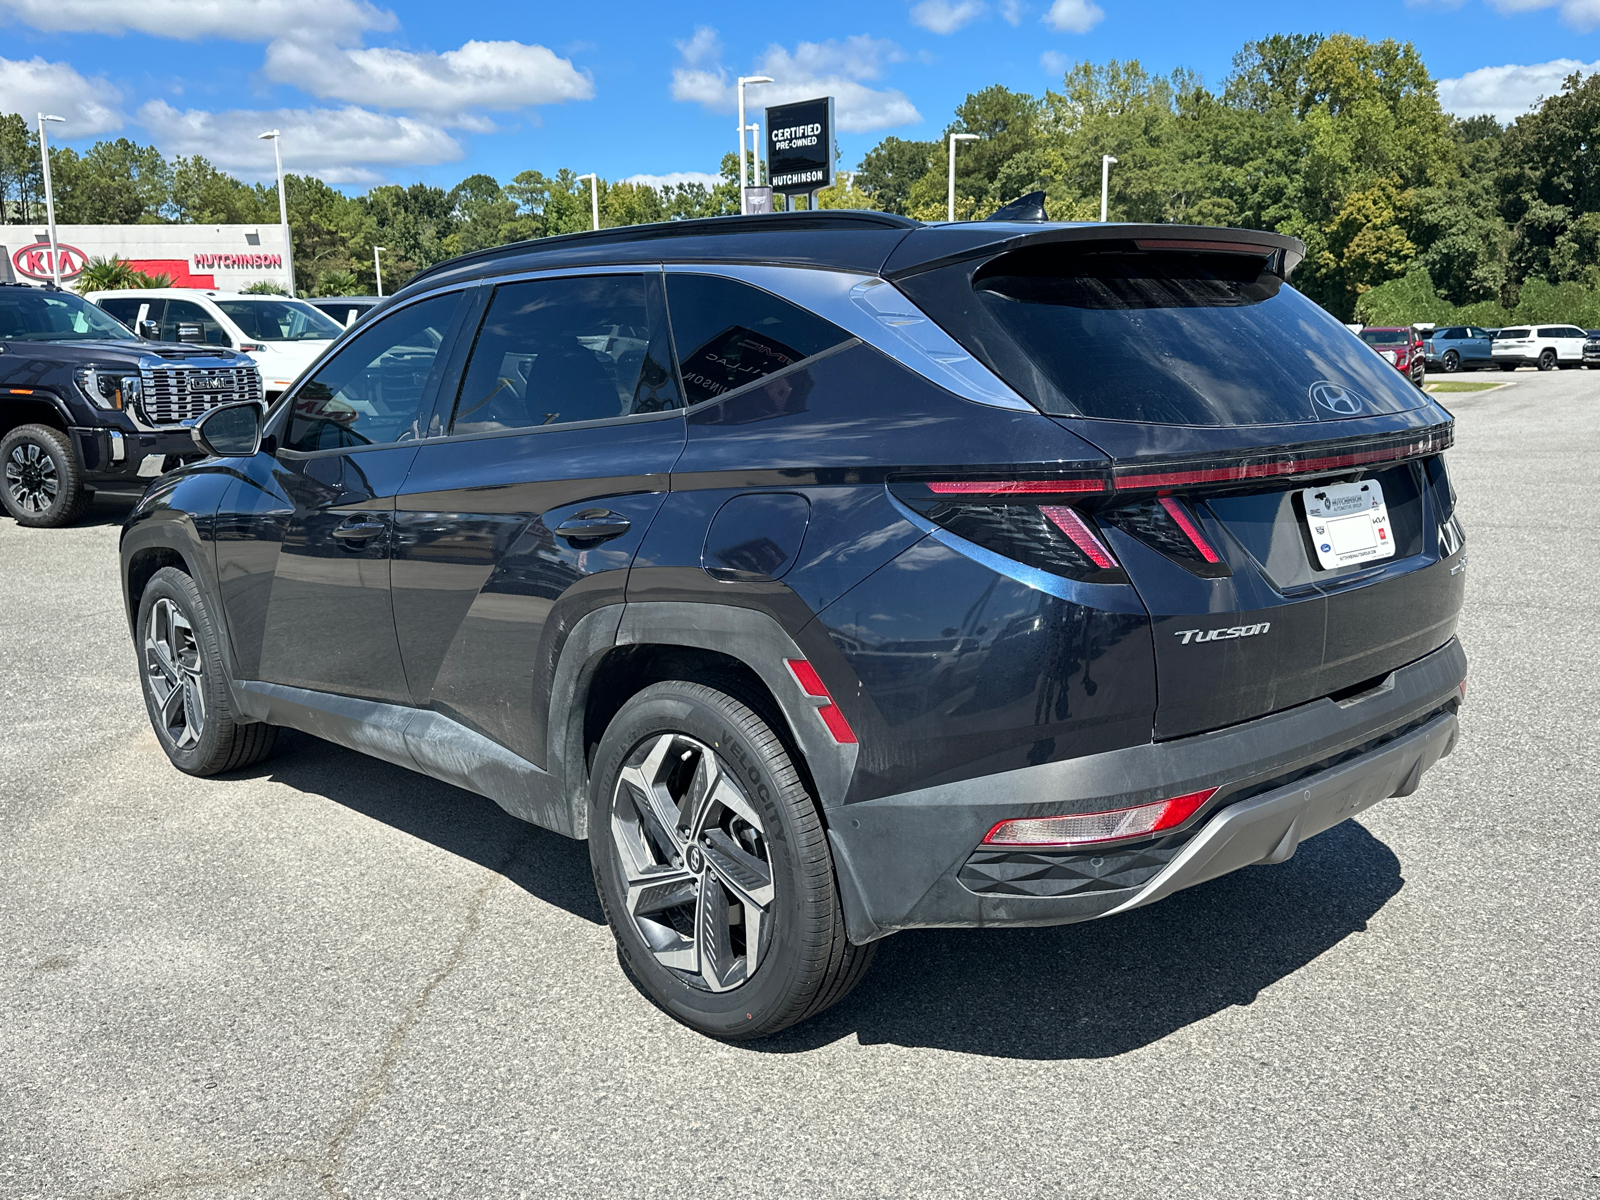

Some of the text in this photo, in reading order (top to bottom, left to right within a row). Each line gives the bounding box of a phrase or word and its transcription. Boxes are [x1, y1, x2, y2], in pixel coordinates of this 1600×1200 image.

[771, 123, 821, 141] CERTIFIED
[775, 136, 817, 151] PRE-OWNED
[772, 170, 823, 186] HUTCHINSON
[25, 250, 77, 272] KIA
[193, 253, 282, 268] HUTCHINSON
[190, 376, 233, 389] GMC
[720, 728, 788, 844] VELOCITY
